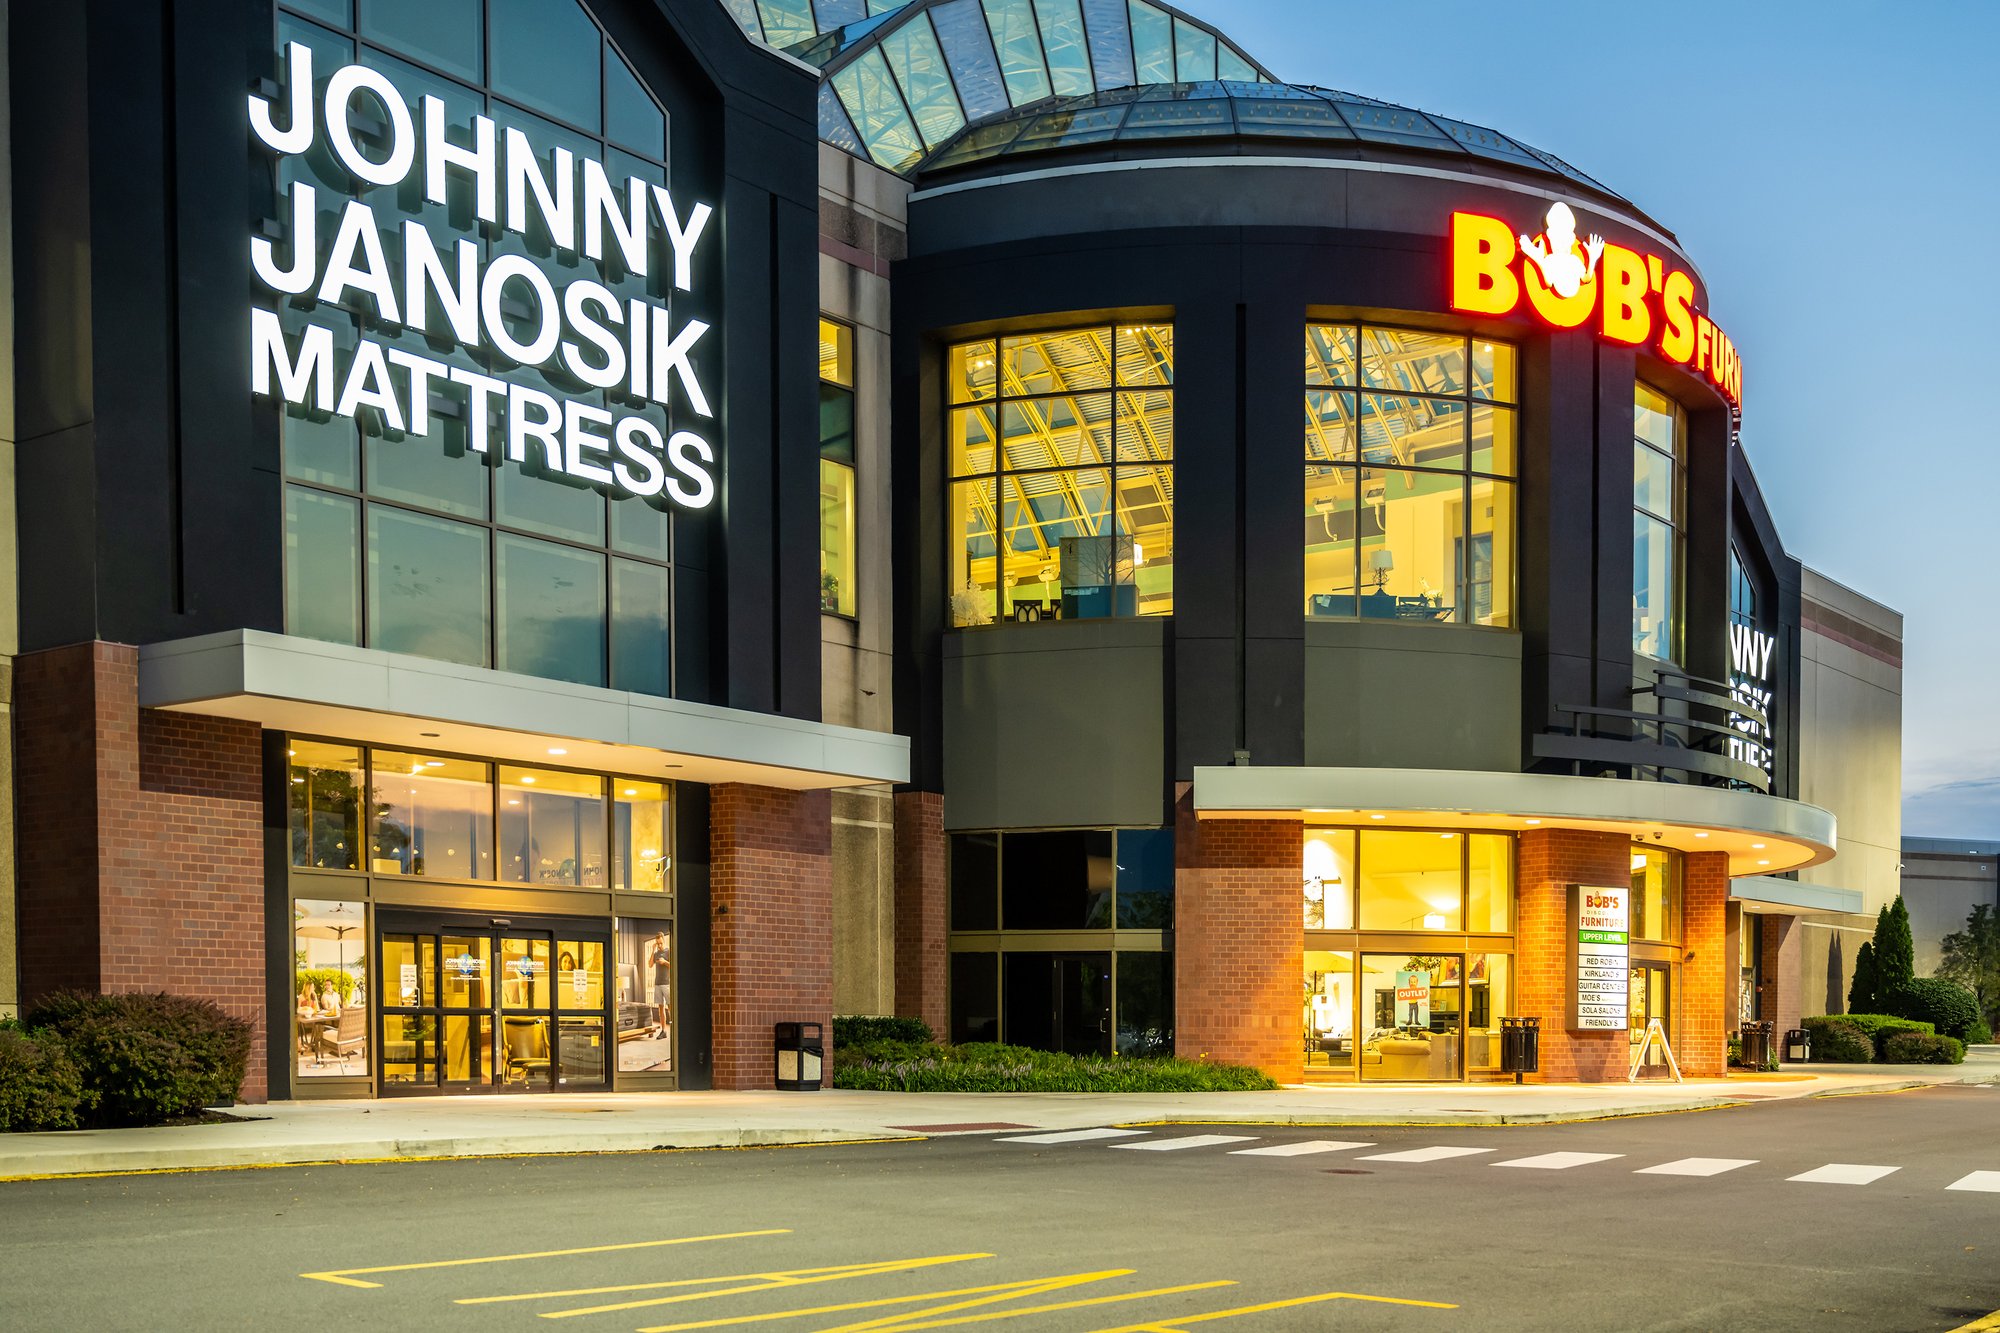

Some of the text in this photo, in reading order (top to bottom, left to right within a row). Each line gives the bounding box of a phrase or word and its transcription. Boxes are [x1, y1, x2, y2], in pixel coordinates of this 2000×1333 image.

[247, 40, 713, 292] JOHNNY
[1450, 210, 1696, 365] BOB'S
[250, 180, 714, 418] JANOSIK
[251, 306, 716, 510] MATTRESS
[1586, 895, 1619, 909] BOB'S
[1581, 916, 1624, 928] FURNITURE
[1583, 932, 1623, 943] UPPER LEVEL
[1586, 957, 1599, 966] RED
[1584, 970, 1620, 979] KIRKLANDS
[1578, 982, 1601, 990] GUITAR
[1399, 990, 1426, 999] OUTLET
[1582, 1006, 1621, 1015] SOLA SALONS
